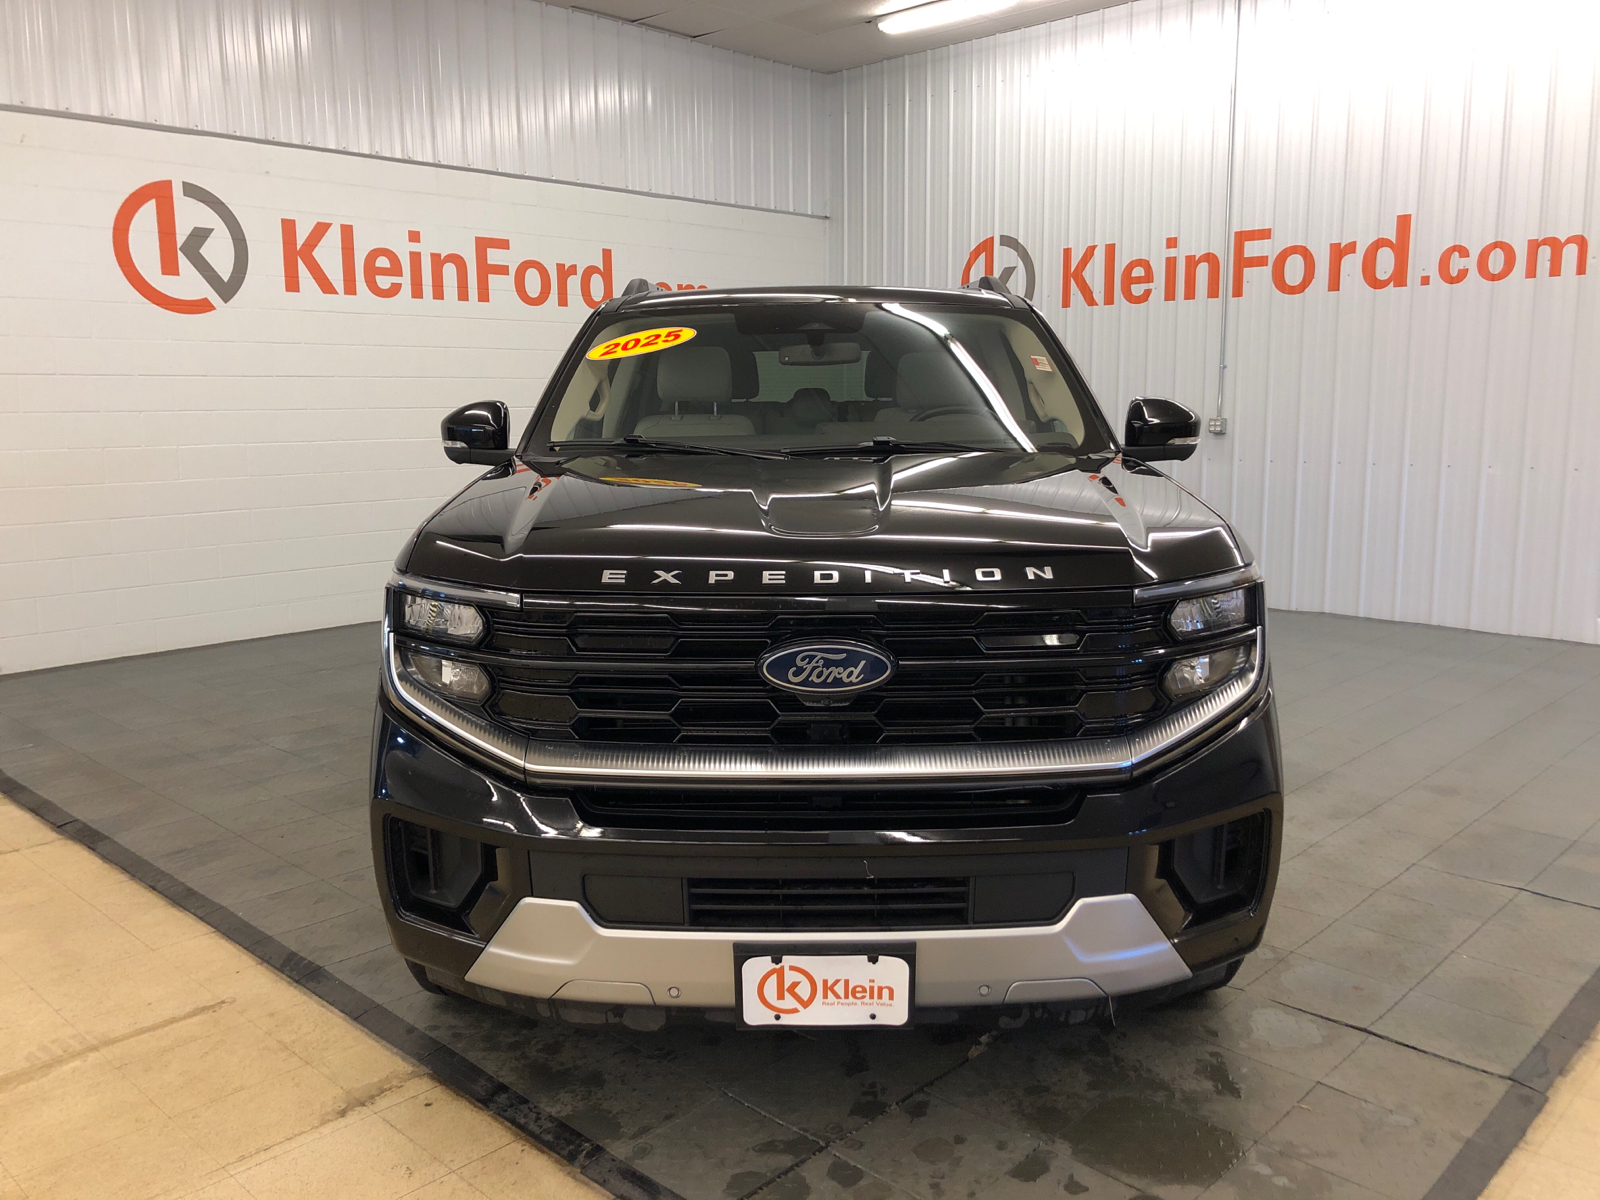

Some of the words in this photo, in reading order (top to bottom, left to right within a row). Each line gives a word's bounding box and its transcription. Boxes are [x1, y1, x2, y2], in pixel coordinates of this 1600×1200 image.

[281, 217, 708, 310] KleinFord
[1061, 213, 1589, 308] KleinFord.com
[598, 328, 684, 358] 2025
[600, 565, 1055, 585] EXPEDITION
[787, 651, 865, 684] Ford
[821, 978, 895, 1001] Klein
[836, 1000, 859, 1008] People.
